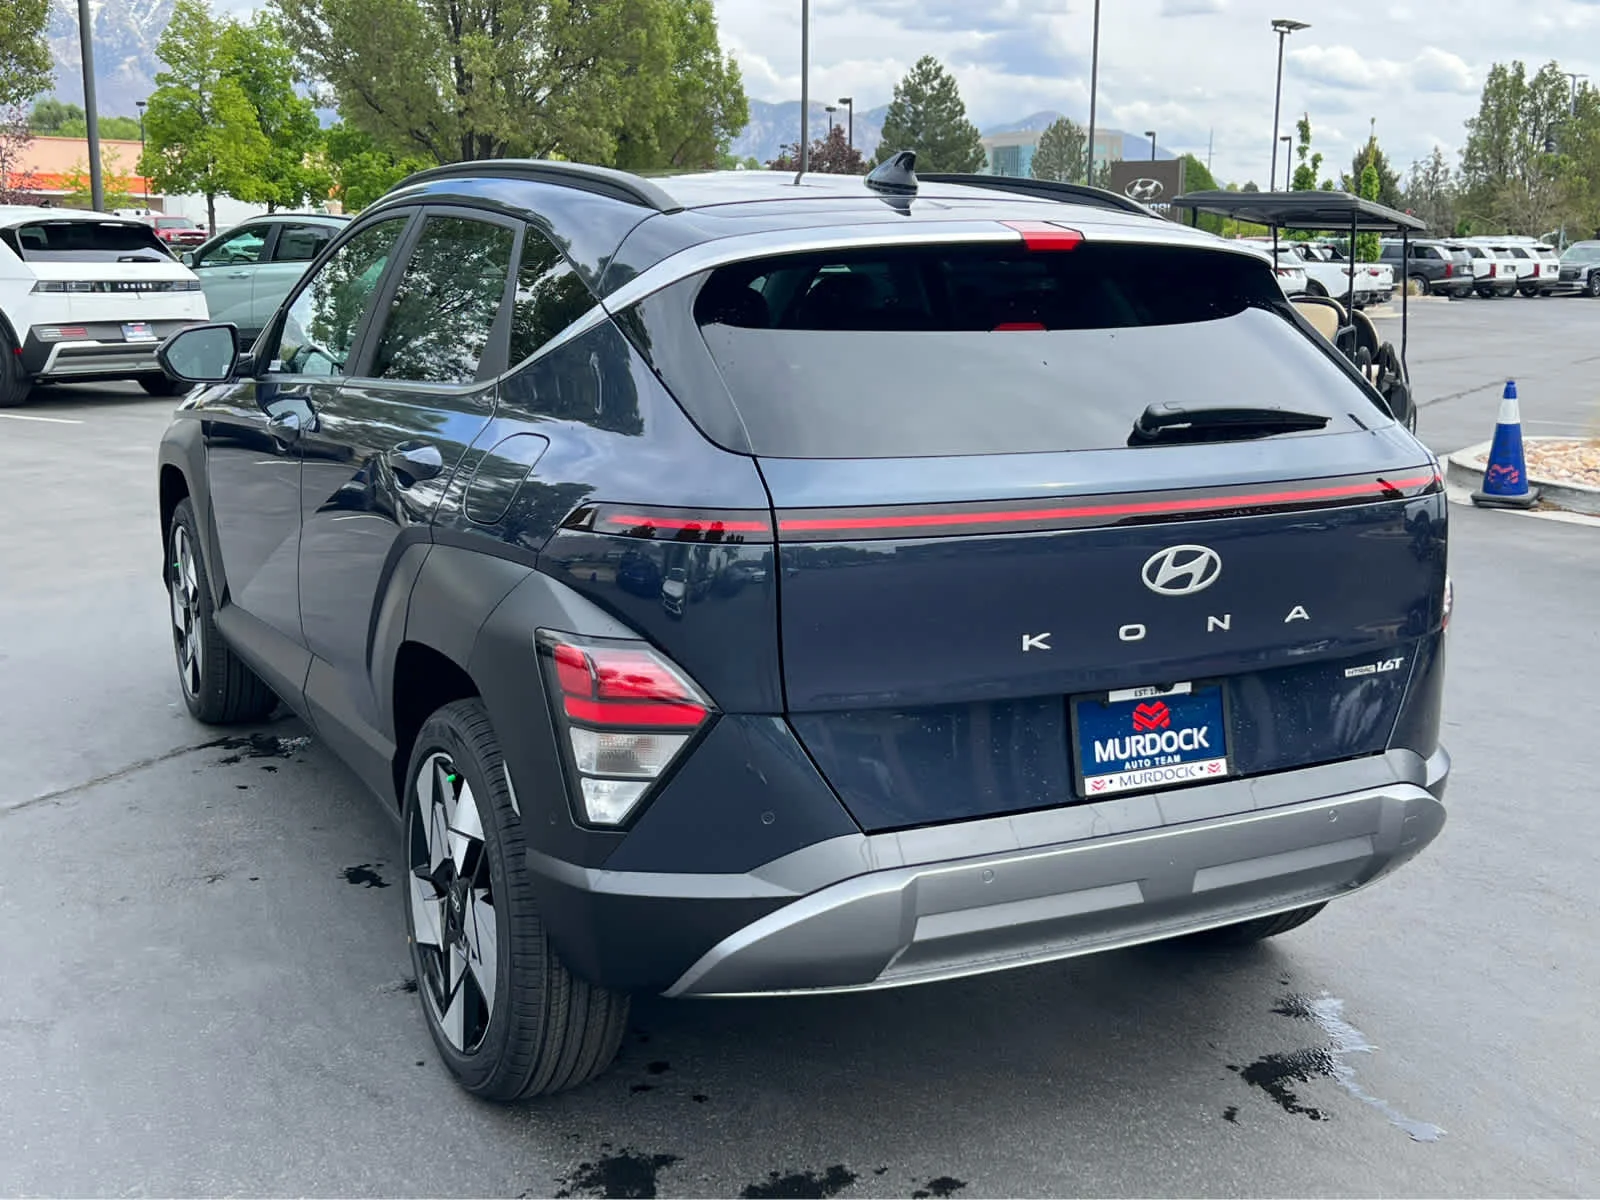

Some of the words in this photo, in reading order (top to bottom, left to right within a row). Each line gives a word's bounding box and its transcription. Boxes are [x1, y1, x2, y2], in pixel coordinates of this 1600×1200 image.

[1022, 605, 1310, 651] KONA
[1094, 726, 1210, 763] MURDOCK
[1119, 765, 1196, 788] MURDOCK
[1124, 758, 1151, 770] AUTO
[1155, 754, 1181, 766] TEAM
